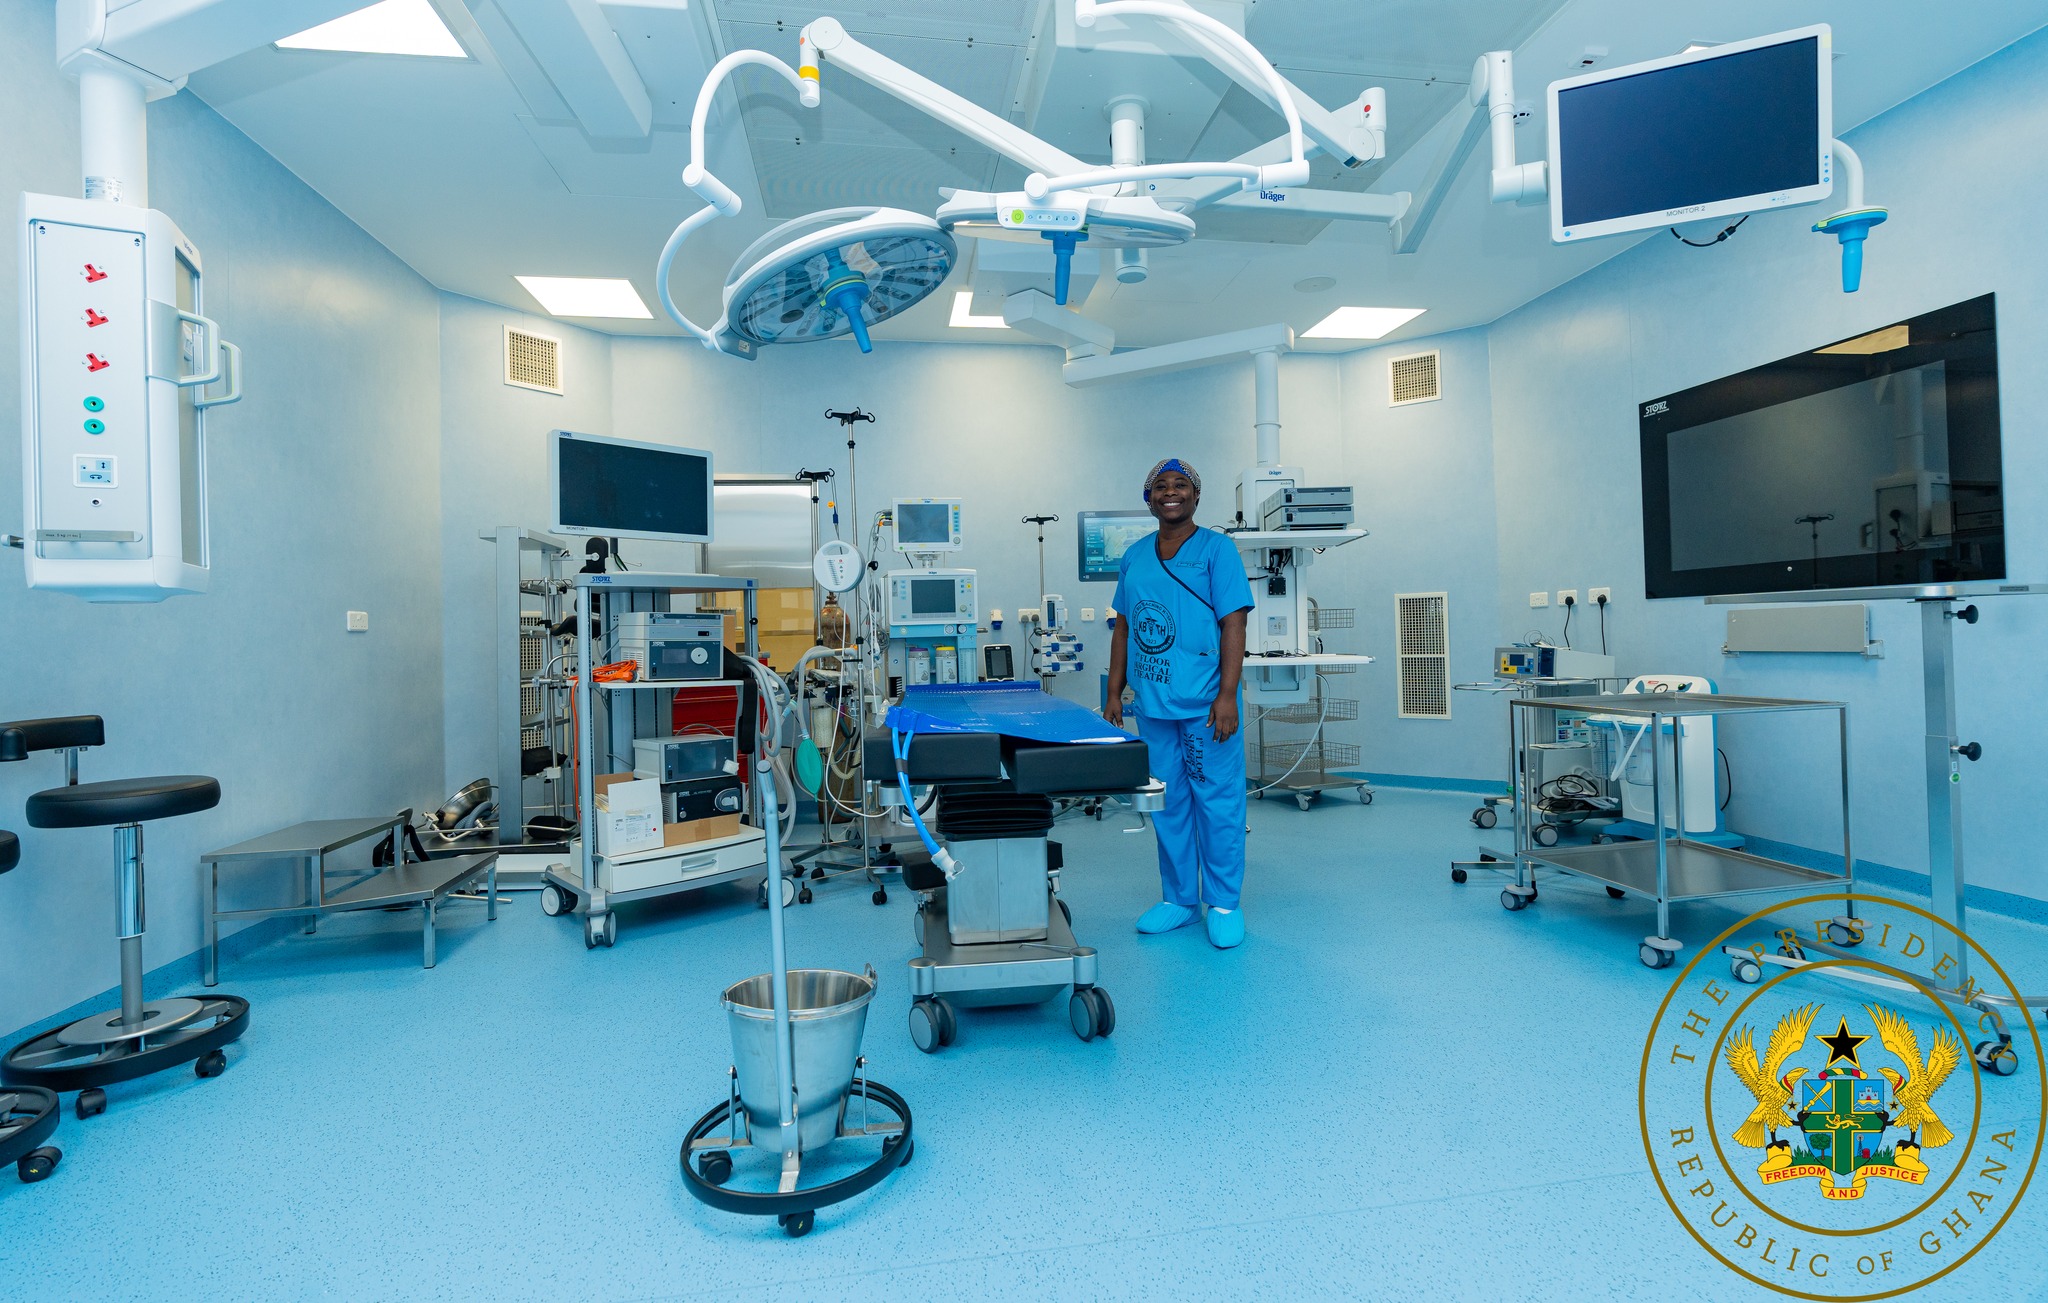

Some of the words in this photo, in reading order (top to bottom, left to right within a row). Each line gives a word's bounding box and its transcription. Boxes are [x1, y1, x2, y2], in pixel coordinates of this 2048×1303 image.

[1260, 190, 1286, 202] Dräger
[1666, 206, 1700, 217] MONITOR
[1645, 400, 1667, 415] STORZ
[1138, 620, 1147, 633] KB
[1155, 624, 1167, 636] TH
[1140, 654, 1171, 667] FLOOR
